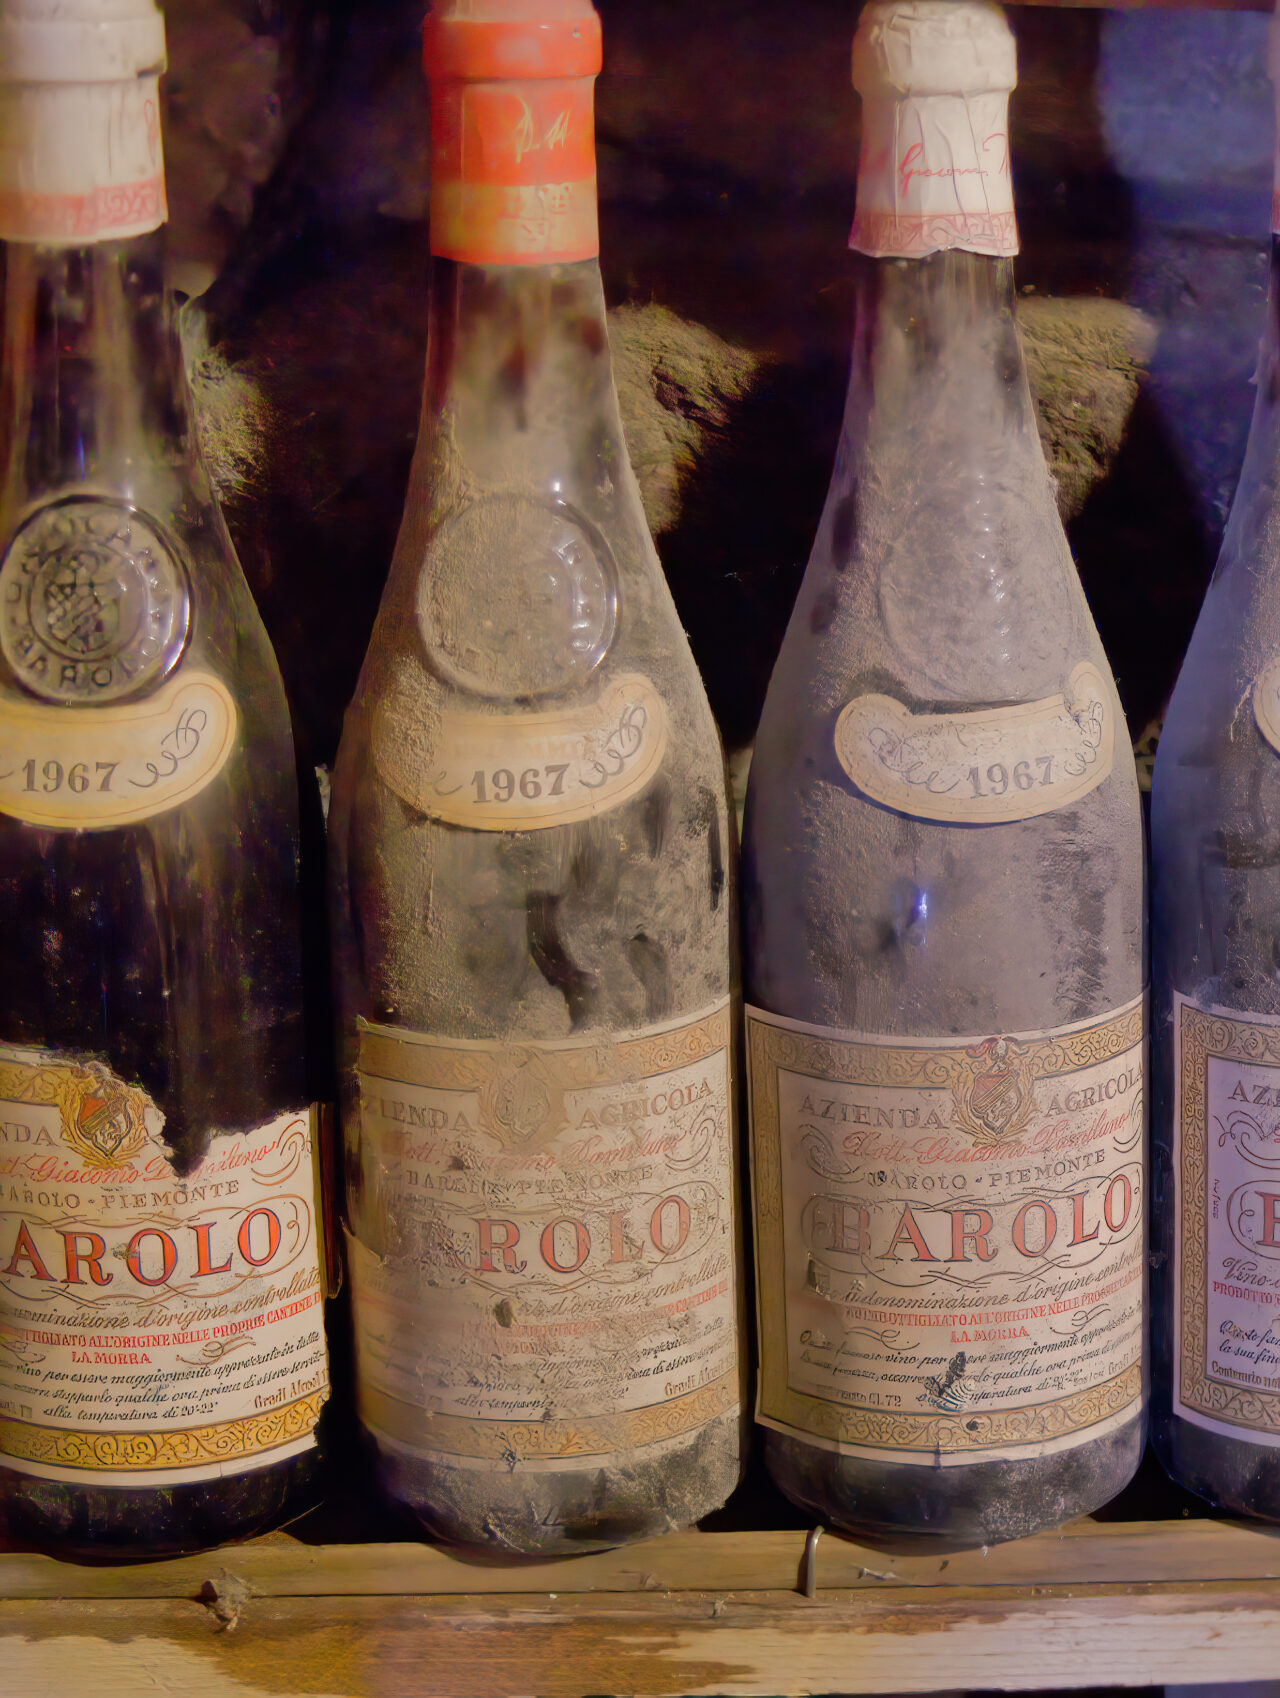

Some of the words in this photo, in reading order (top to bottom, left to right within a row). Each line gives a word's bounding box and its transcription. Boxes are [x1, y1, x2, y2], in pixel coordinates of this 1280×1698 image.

[22, 758, 120, 792] 1967
[471, 763, 570, 804] 1967
[965, 755, 1056, 799] 1967
[798, 1093, 950, 1130] AZIENDA
[988, 1149, 1106, 1188] PIEMONTE
[101, 1179, 240, 1210] PIEMONTE
[825, 1172, 1133, 1263] BAROLO
[1, 1207, 282, 1287] AROLO
[1213, 1281, 1273, 1304] PRODOTTO
